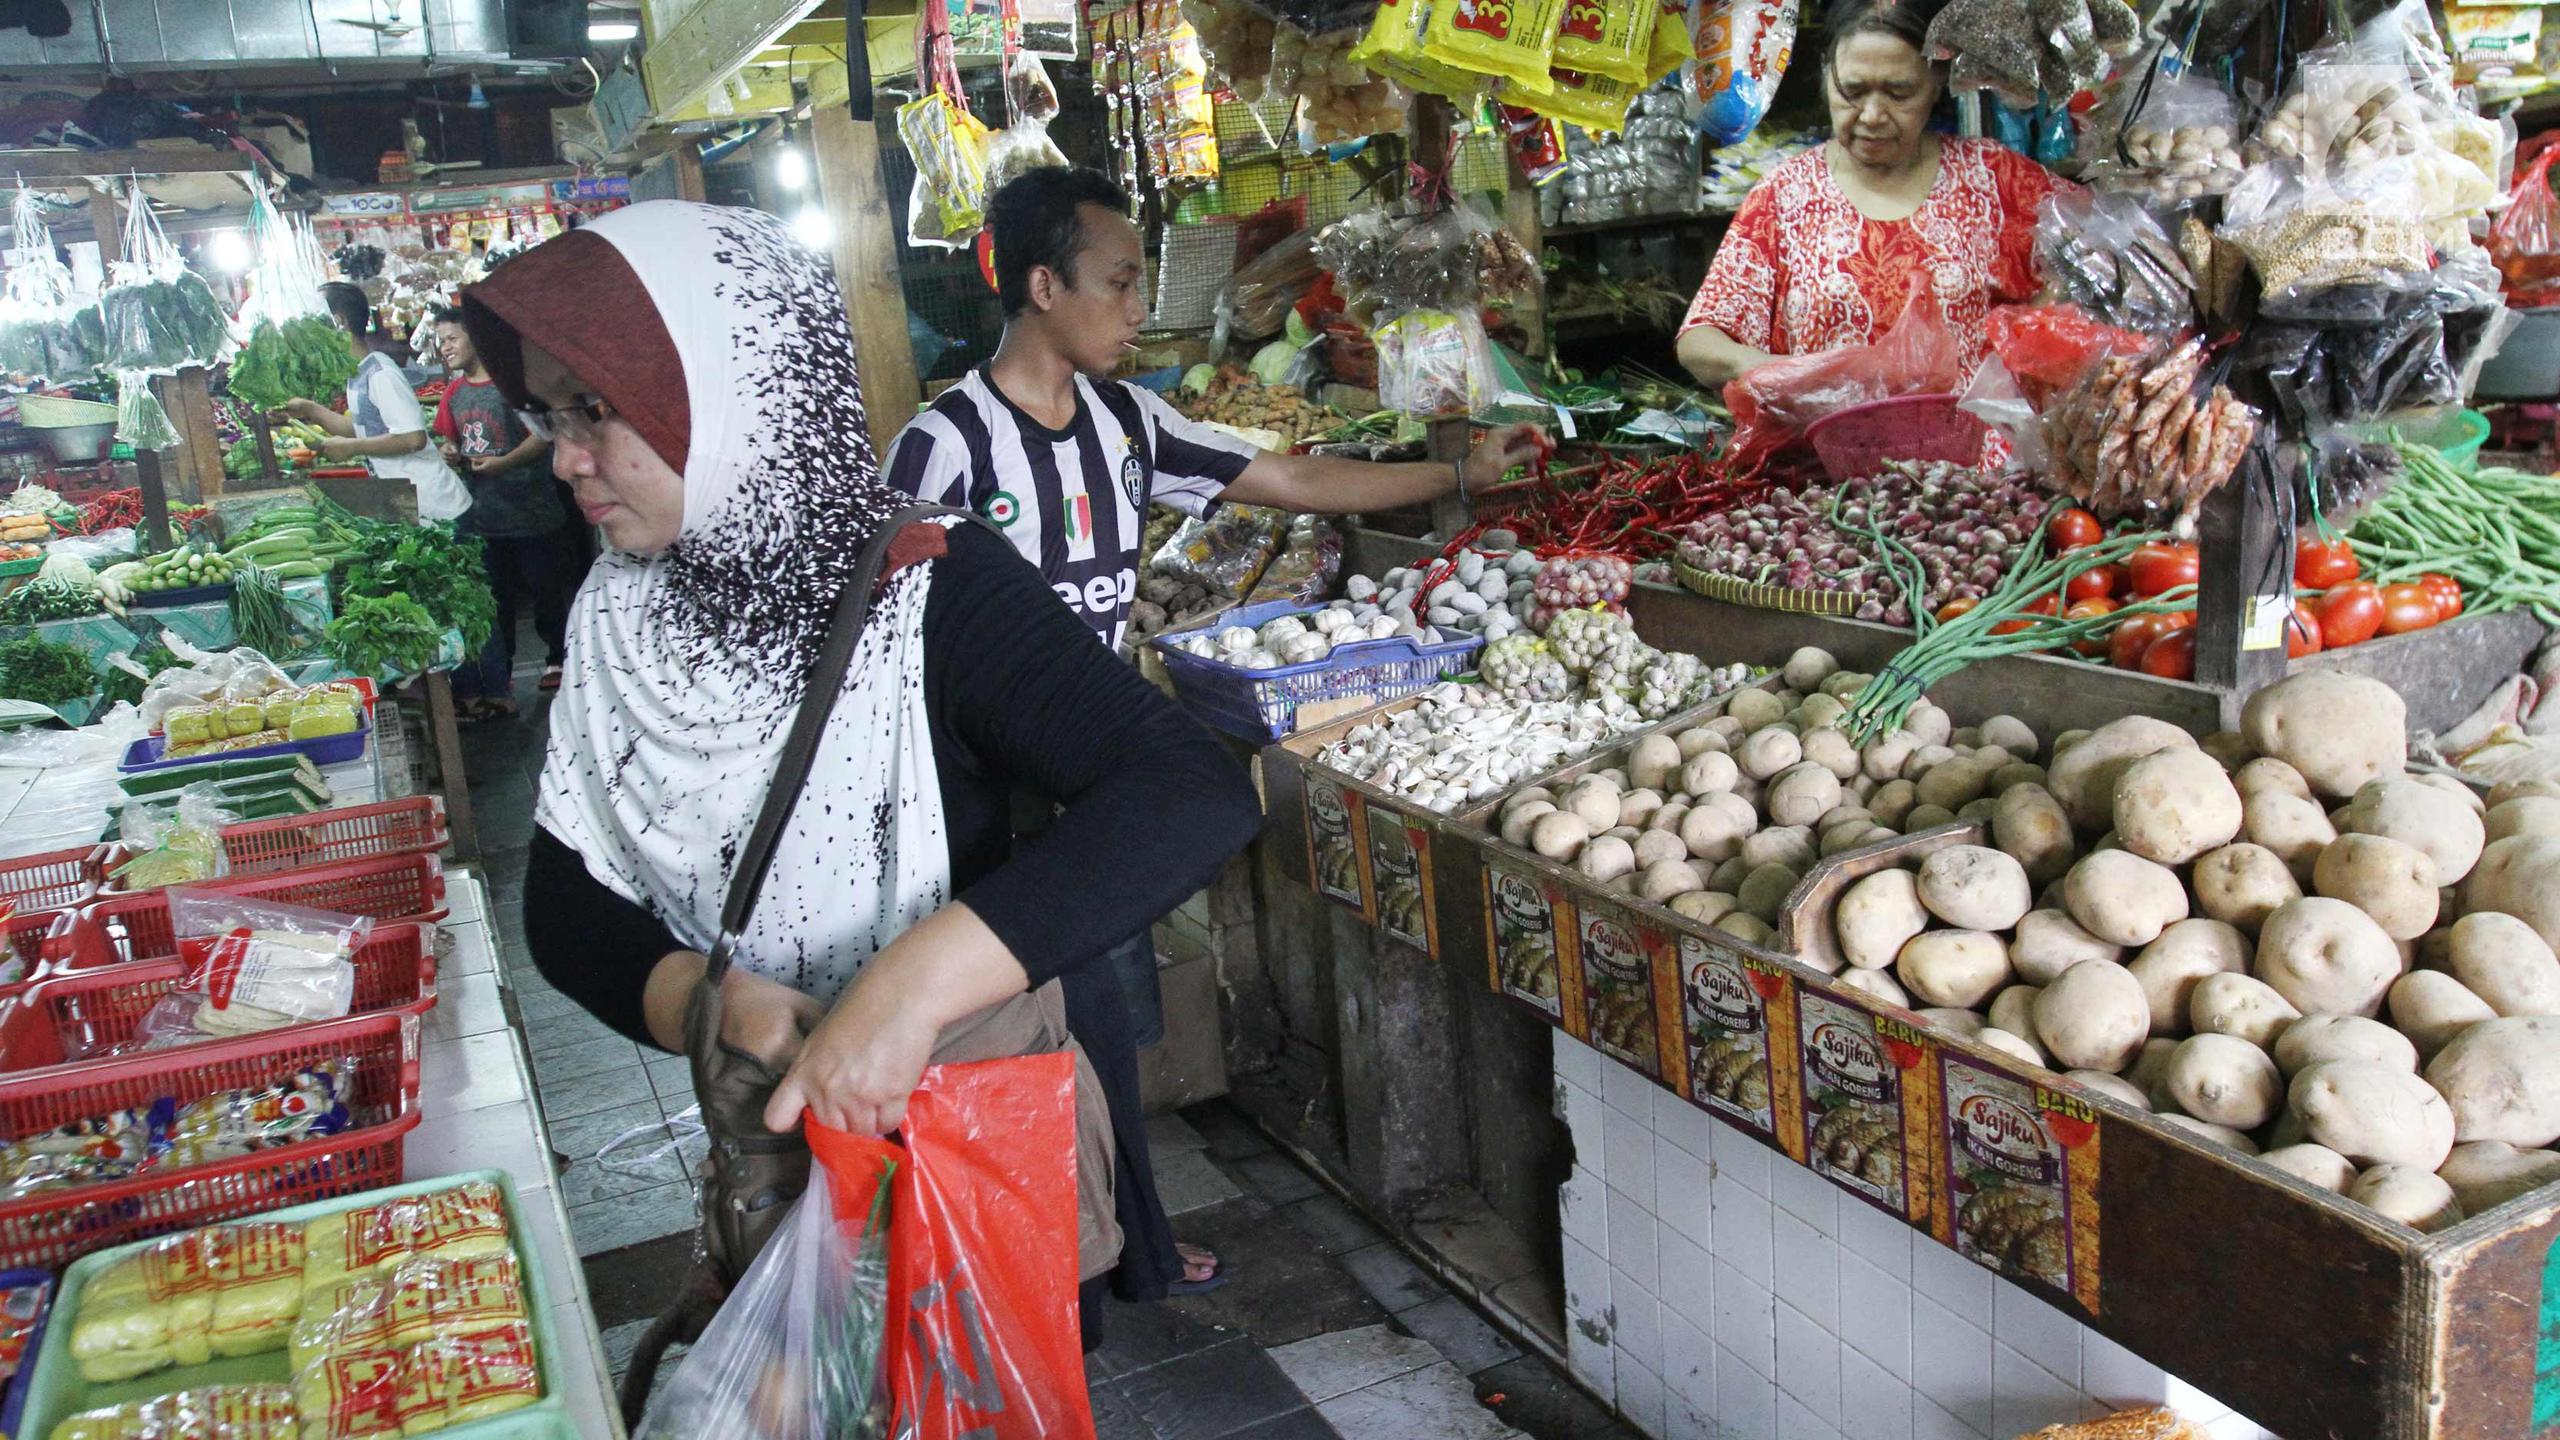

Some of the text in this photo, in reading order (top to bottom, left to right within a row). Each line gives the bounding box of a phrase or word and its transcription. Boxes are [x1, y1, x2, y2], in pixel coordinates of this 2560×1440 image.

[1051, 568, 1136, 617] eep
[1505, 879, 1538, 908] Saju
[1701, 968, 1745, 1003] Sajiku
[1697, 1000, 1751, 1029] IKAN GORENG
[1873, 1014, 1923, 1048] BARU
[1823, 1029, 1875, 1069] Sajiku
[1818, 1062, 1882, 1099] IKAN GORENG
[1972, 1102, 2035, 1145] Sajiku
[2036, 1086, 2095, 1124] BARU
[1966, 1136, 2043, 1181] IKAN GORENG
